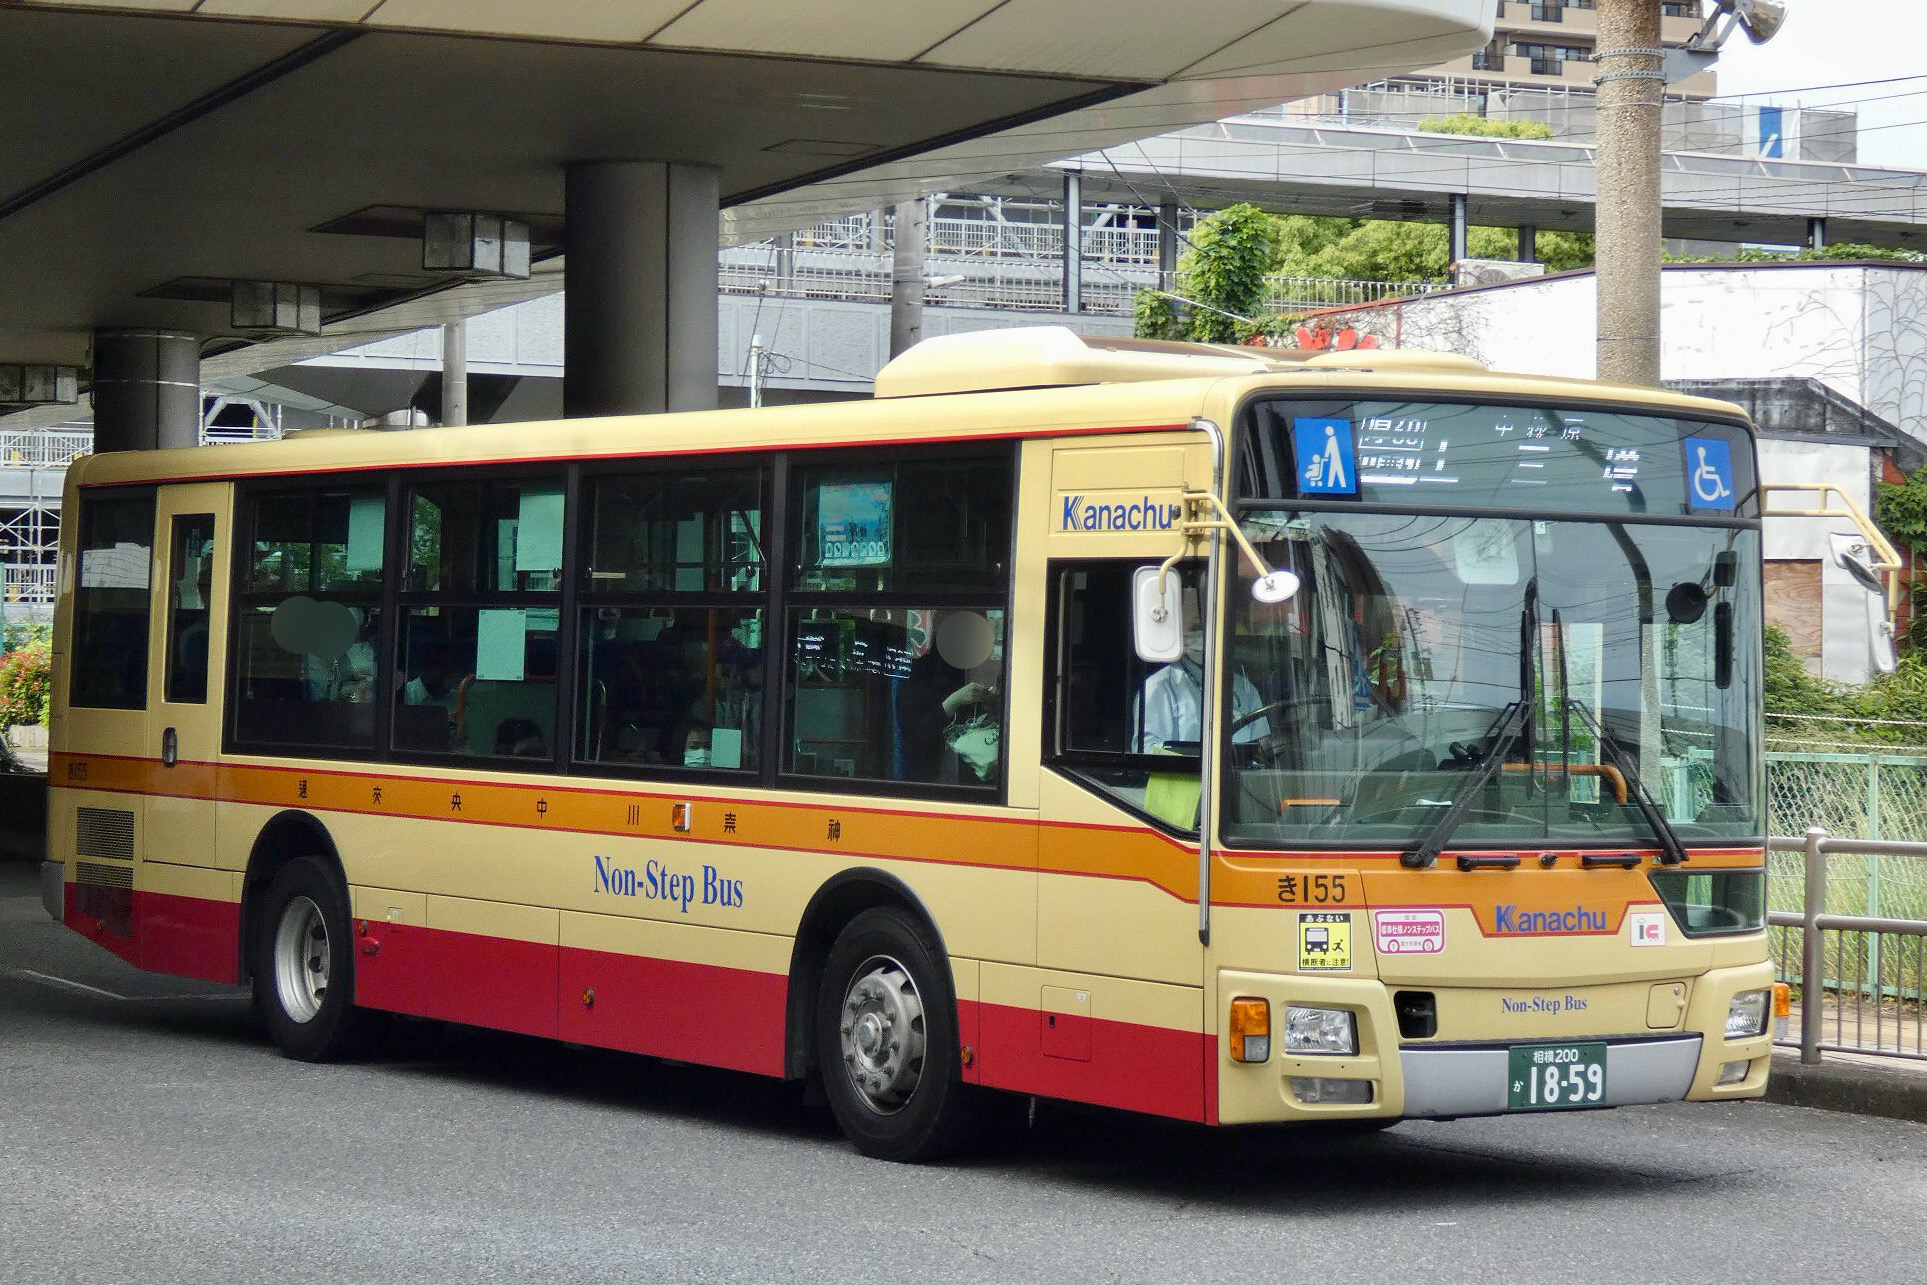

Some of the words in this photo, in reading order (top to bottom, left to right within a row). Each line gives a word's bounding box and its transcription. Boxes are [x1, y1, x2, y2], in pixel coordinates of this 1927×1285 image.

[1062, 496, 1173, 531] Kanachu
[593, 855, 695, 914] Non-Step
[701, 864, 744, 909] Bus
[1277, 875, 1346, 904] き155
[1305, 914, 1344, 923] あぶない
[1496, 904, 1607, 933] Kanachu
[1502, 996, 1561, 1015] Non-Step
[1564, 995, 1588, 1011] Bus
[1533, 1048, 1579, 1064] 相模200
[1513, 1080, 1524, 1093] か
[1530, 1063, 1603, 1104] 18-59
